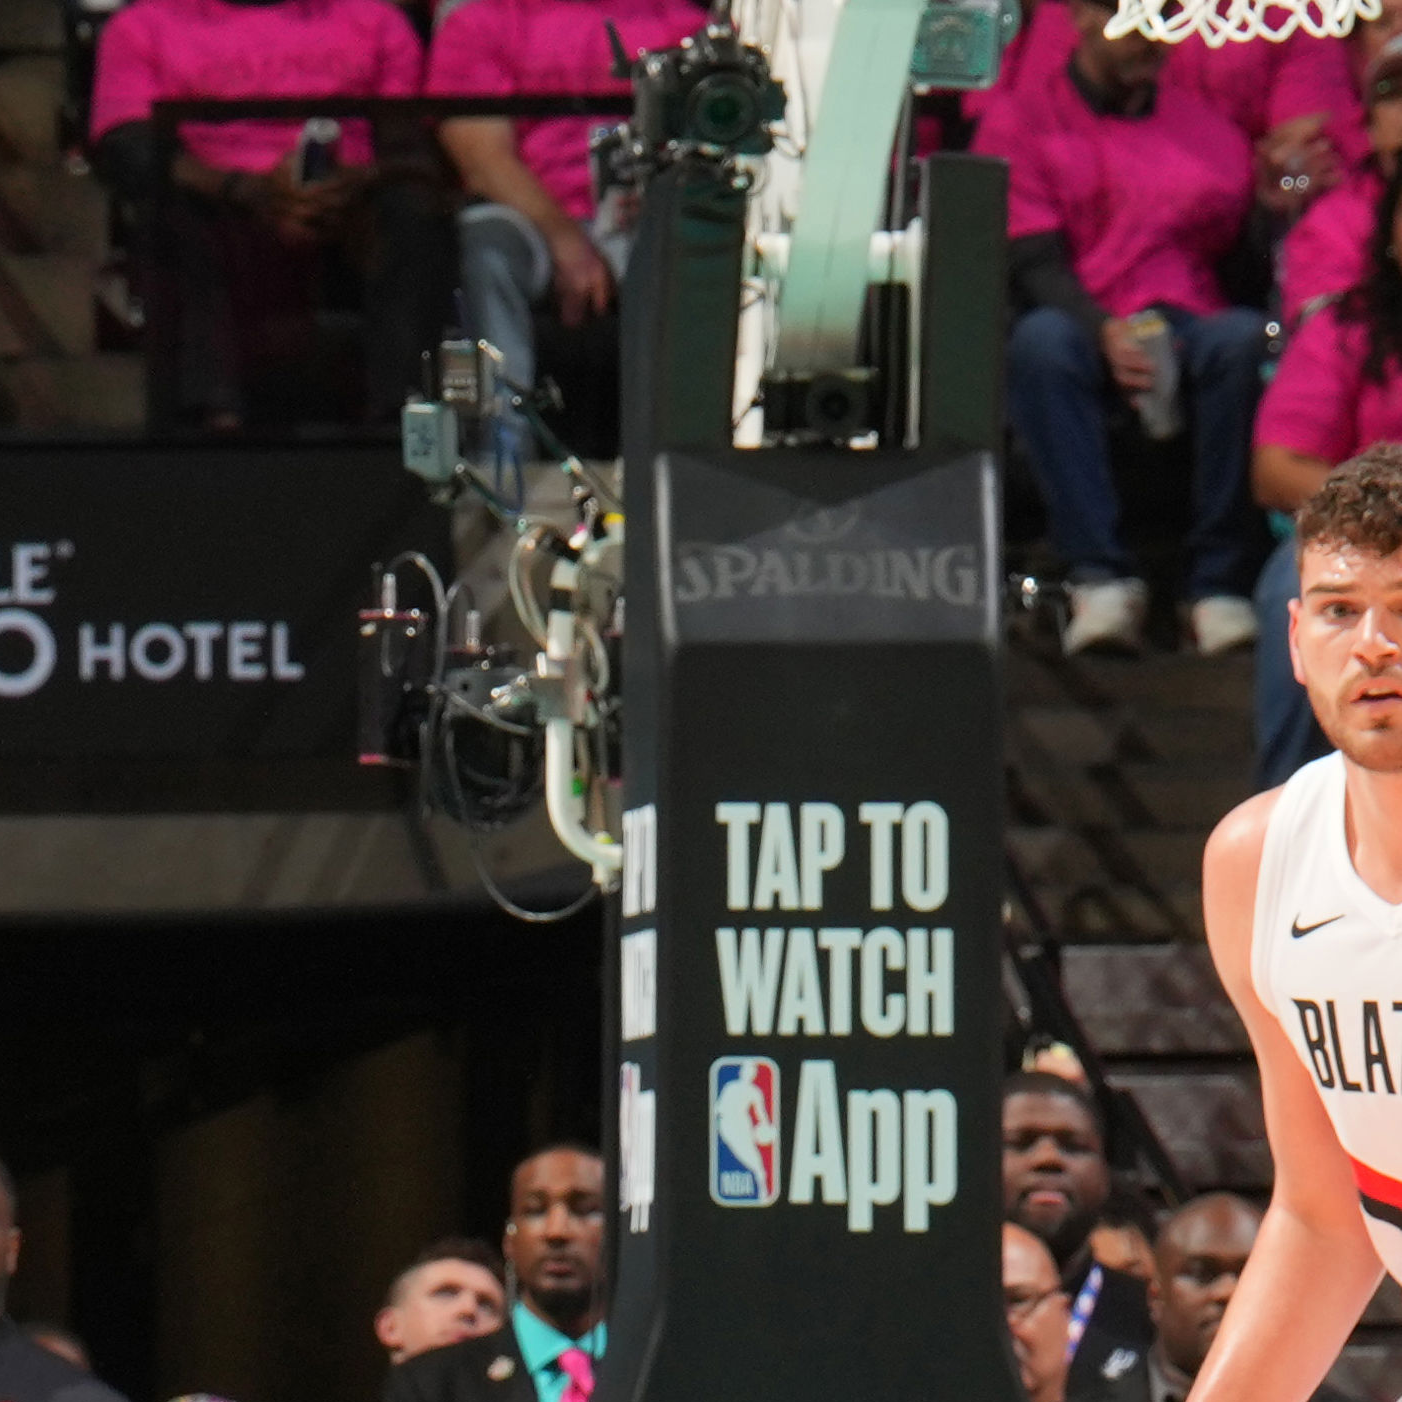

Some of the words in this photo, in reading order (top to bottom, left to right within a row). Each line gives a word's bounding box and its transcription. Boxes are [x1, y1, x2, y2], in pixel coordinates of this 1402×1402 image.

[675, 544, 979, 606] SPALDING
[79, 621, 305, 683] HOTEL
[715, 801, 846, 913] TAP
[859, 801, 950, 913] TO
[716, 927, 956, 1037] WATCH
[788, 1059, 959, 1233] App
